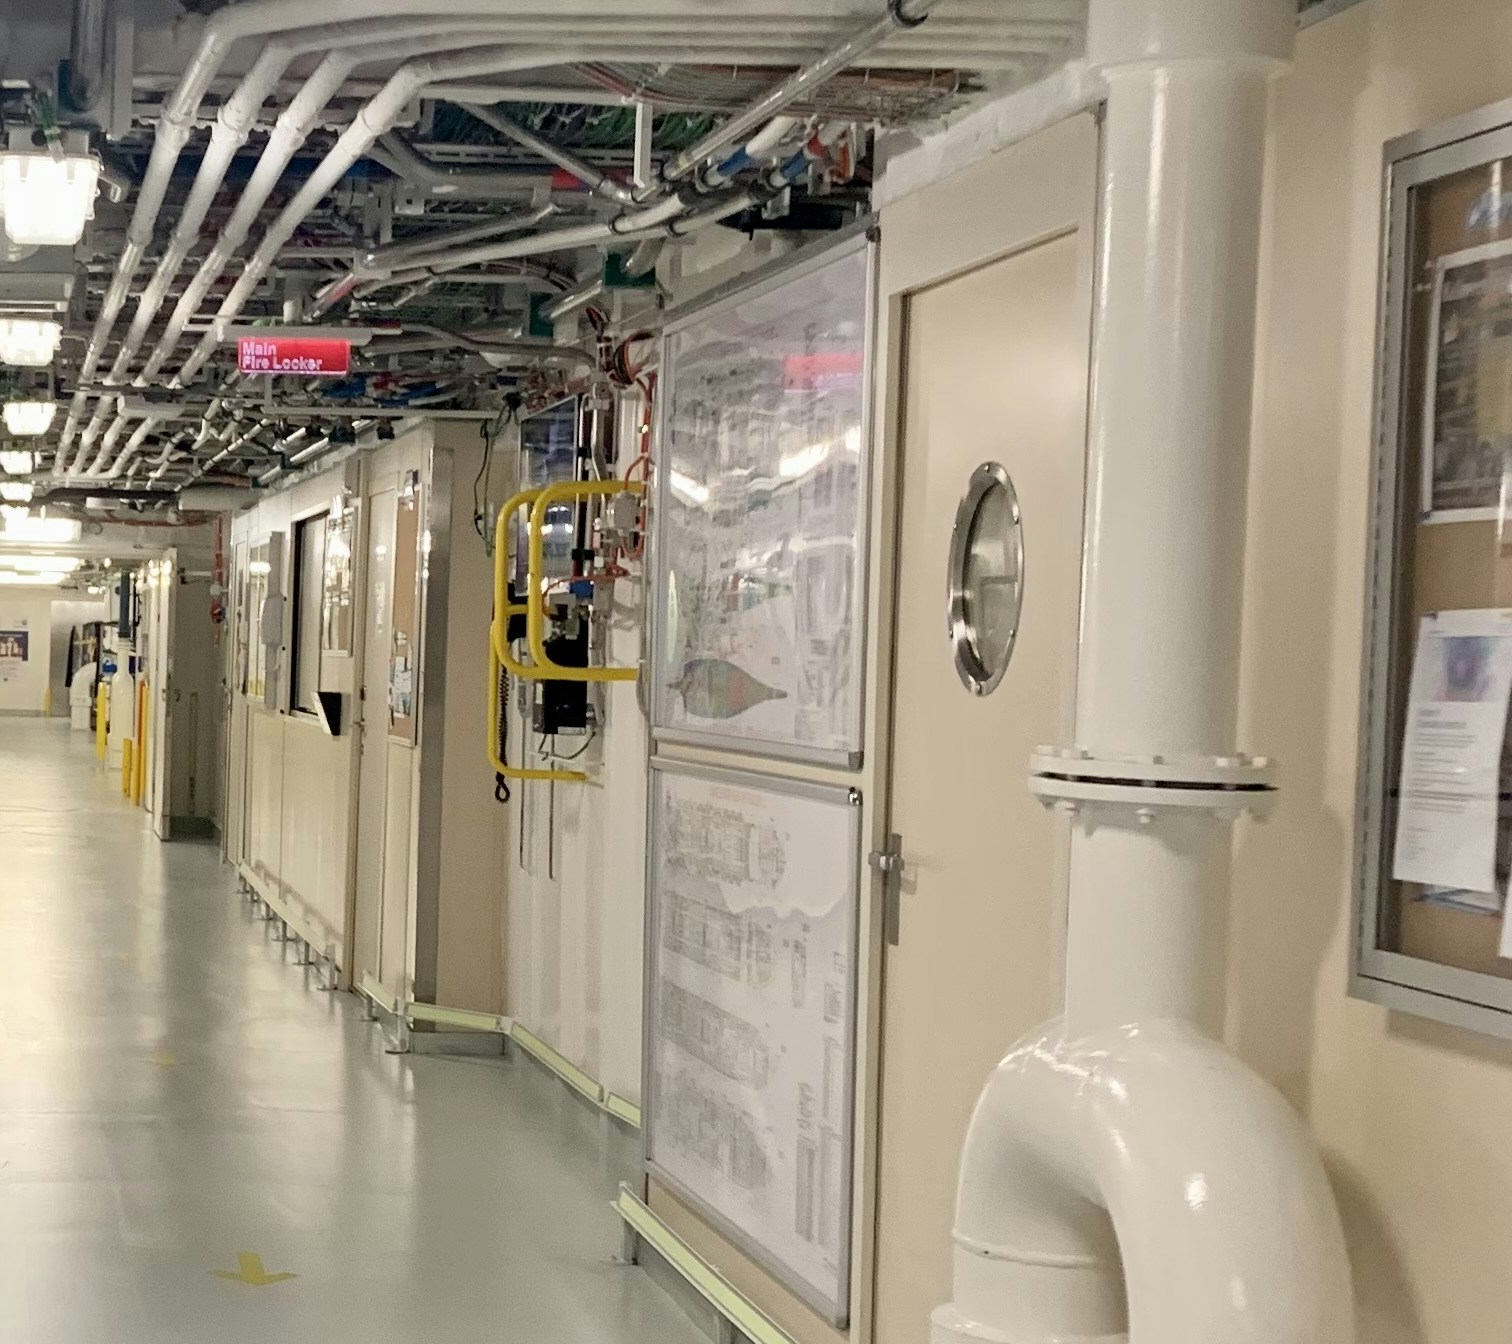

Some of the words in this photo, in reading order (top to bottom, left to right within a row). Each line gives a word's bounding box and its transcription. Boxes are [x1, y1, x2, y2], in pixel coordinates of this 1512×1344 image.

[242, 341, 277, 356] Main
[242, 357, 270, 370] Fire
[272, 357, 322, 371] Locker
